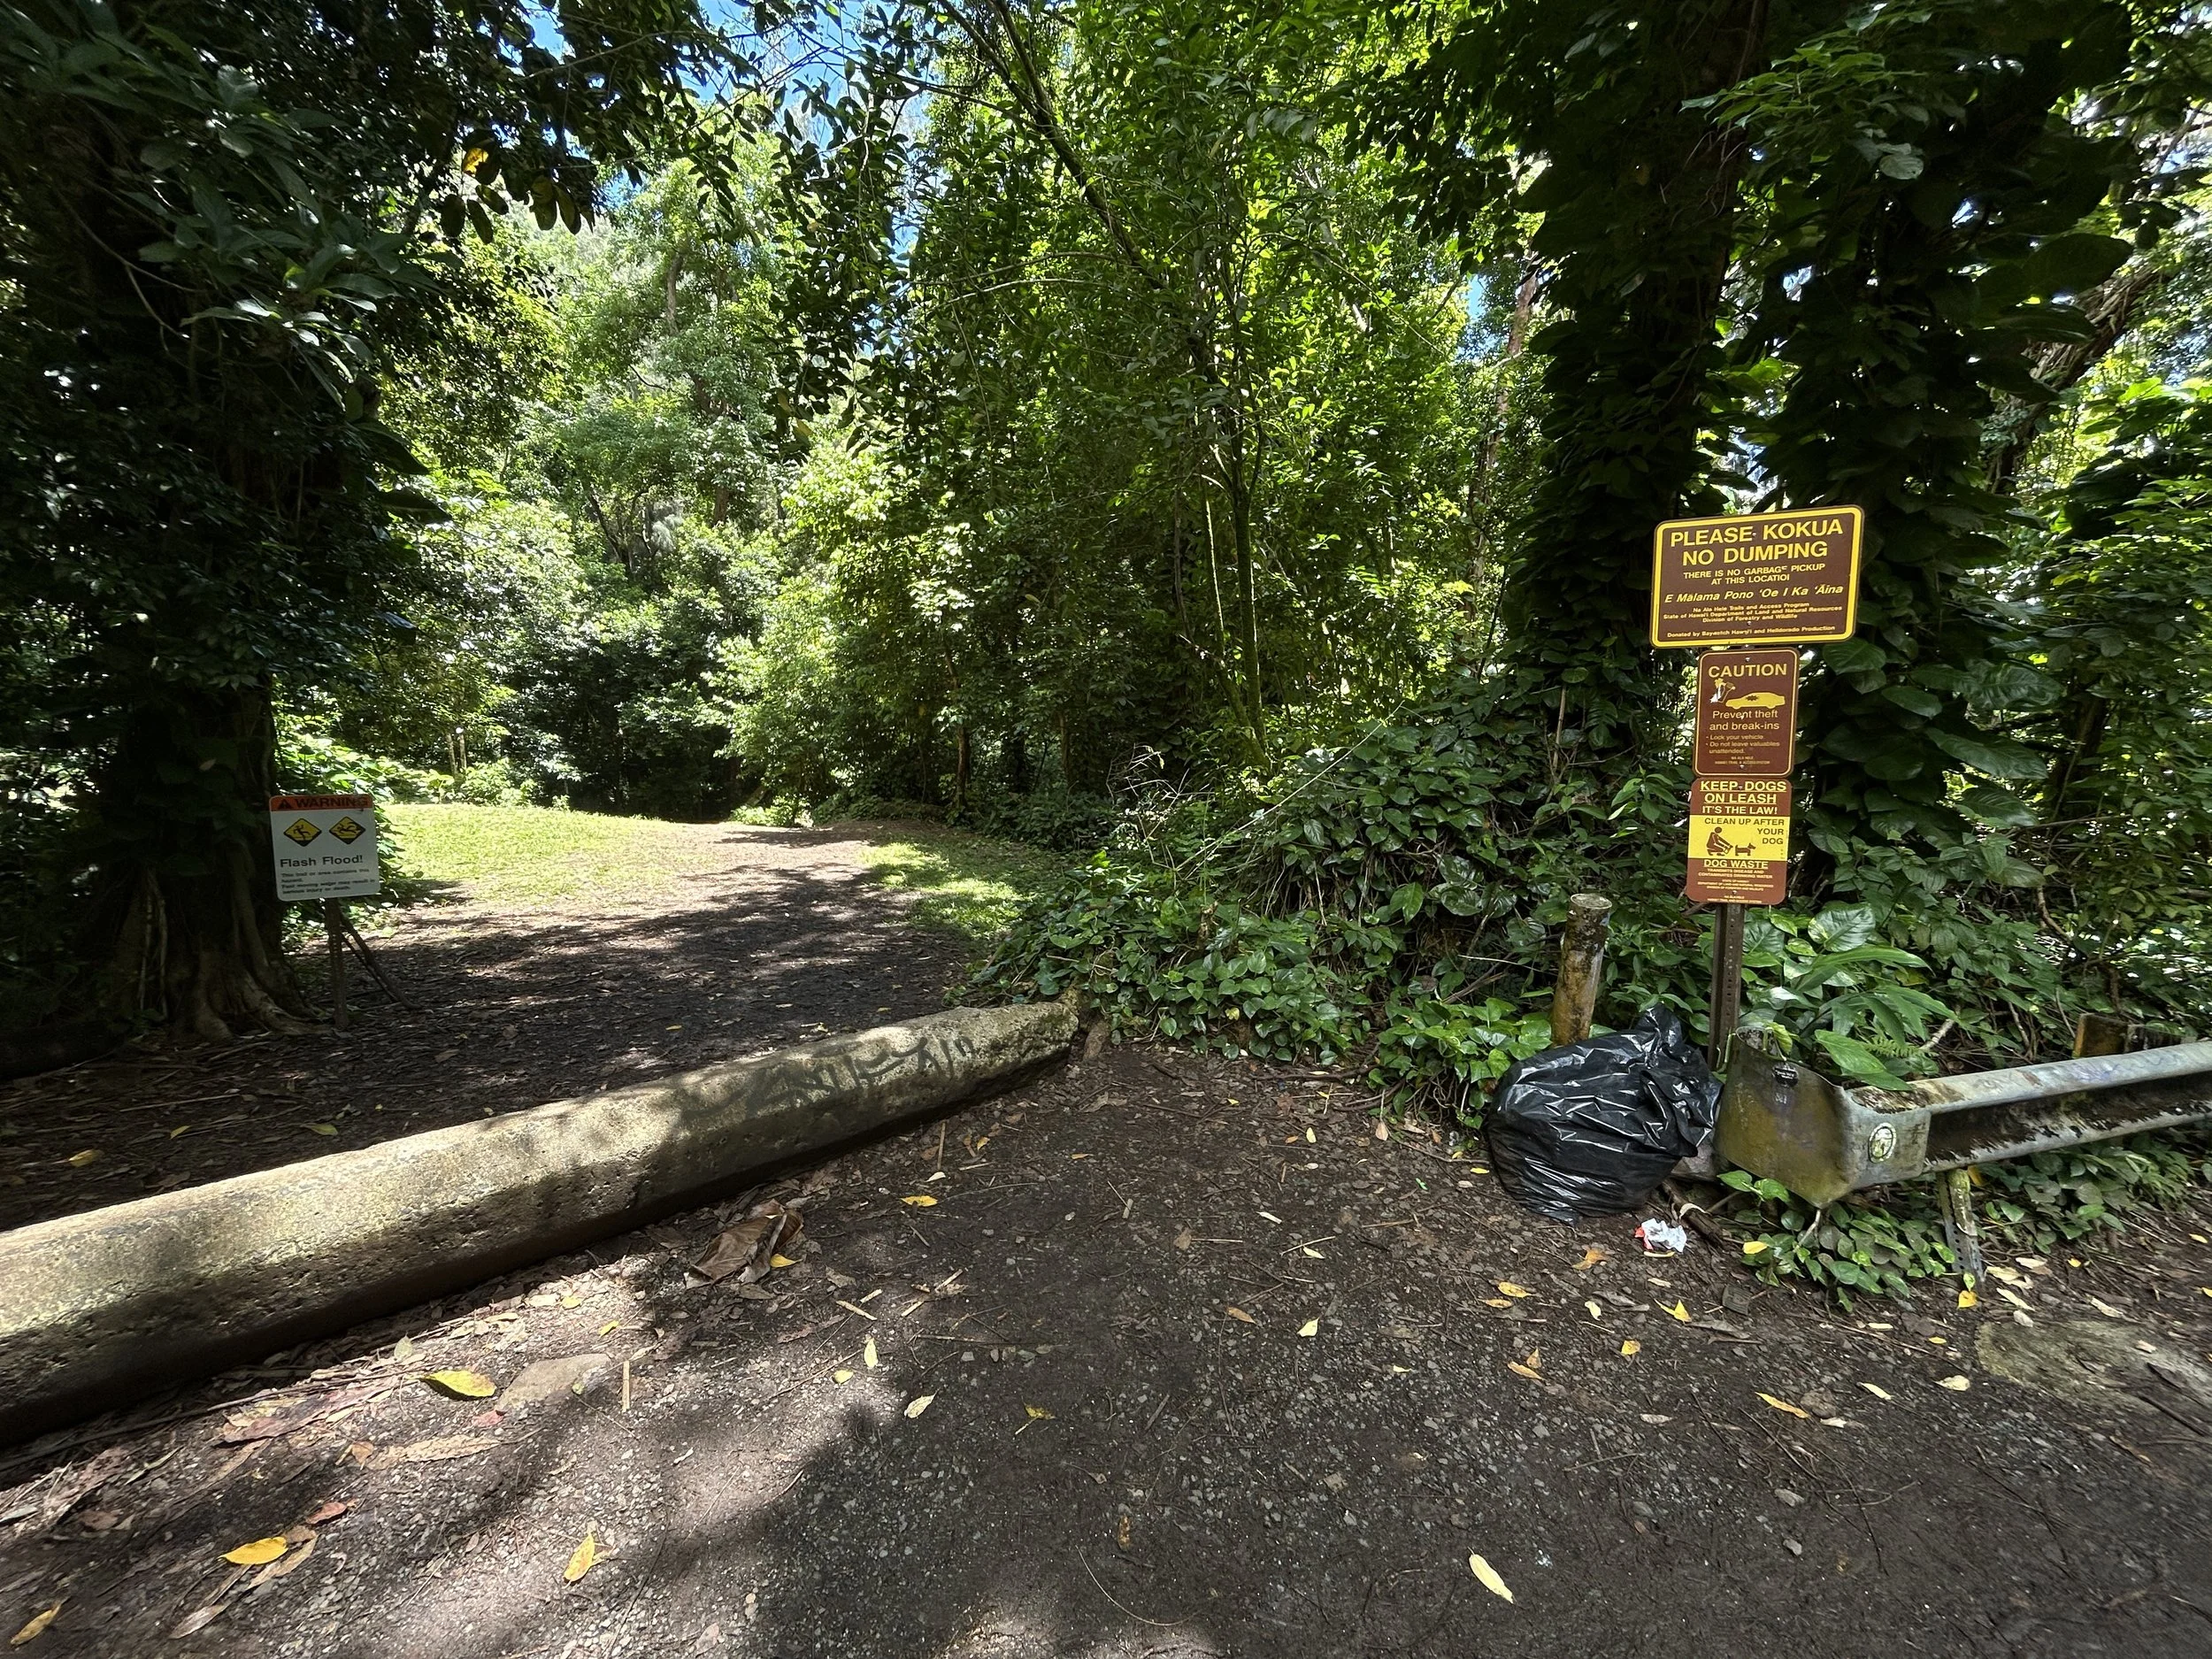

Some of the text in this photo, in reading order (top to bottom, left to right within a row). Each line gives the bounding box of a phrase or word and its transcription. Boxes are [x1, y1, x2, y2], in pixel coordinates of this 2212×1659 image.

[1671, 518, 1843, 548] PLEASE KOKUA
[1682, 541, 1828, 566] NO DUMPING
[1683, 571, 1712, 580] THERE
[1791, 563, 1826, 572] PICKUP
[1664, 594, 1674, 603] E
[1724, 590, 1755, 600] Pono
[1782, 587, 1789, 597] I
[1791, 586, 1809, 596] Ka
[1708, 663, 1787, 679] CAUTION
[1712, 709, 1778, 719] Prevent theft
[1709, 719, 1781, 732] and break-ins
[1700, 780, 1787, 793] KEEP DOGS
[296, 797, 368, 809] WARNING
[1704, 793, 1777, 804] ON LEASH
[1701, 805, 1723, 814] IT'S
[1749, 806, 1778, 815] LAW!
[1756, 827, 1785, 836] YOUR
[280, 855, 364, 868] Flash Flood!
[1703, 859, 1769, 870] DOG WASTE
